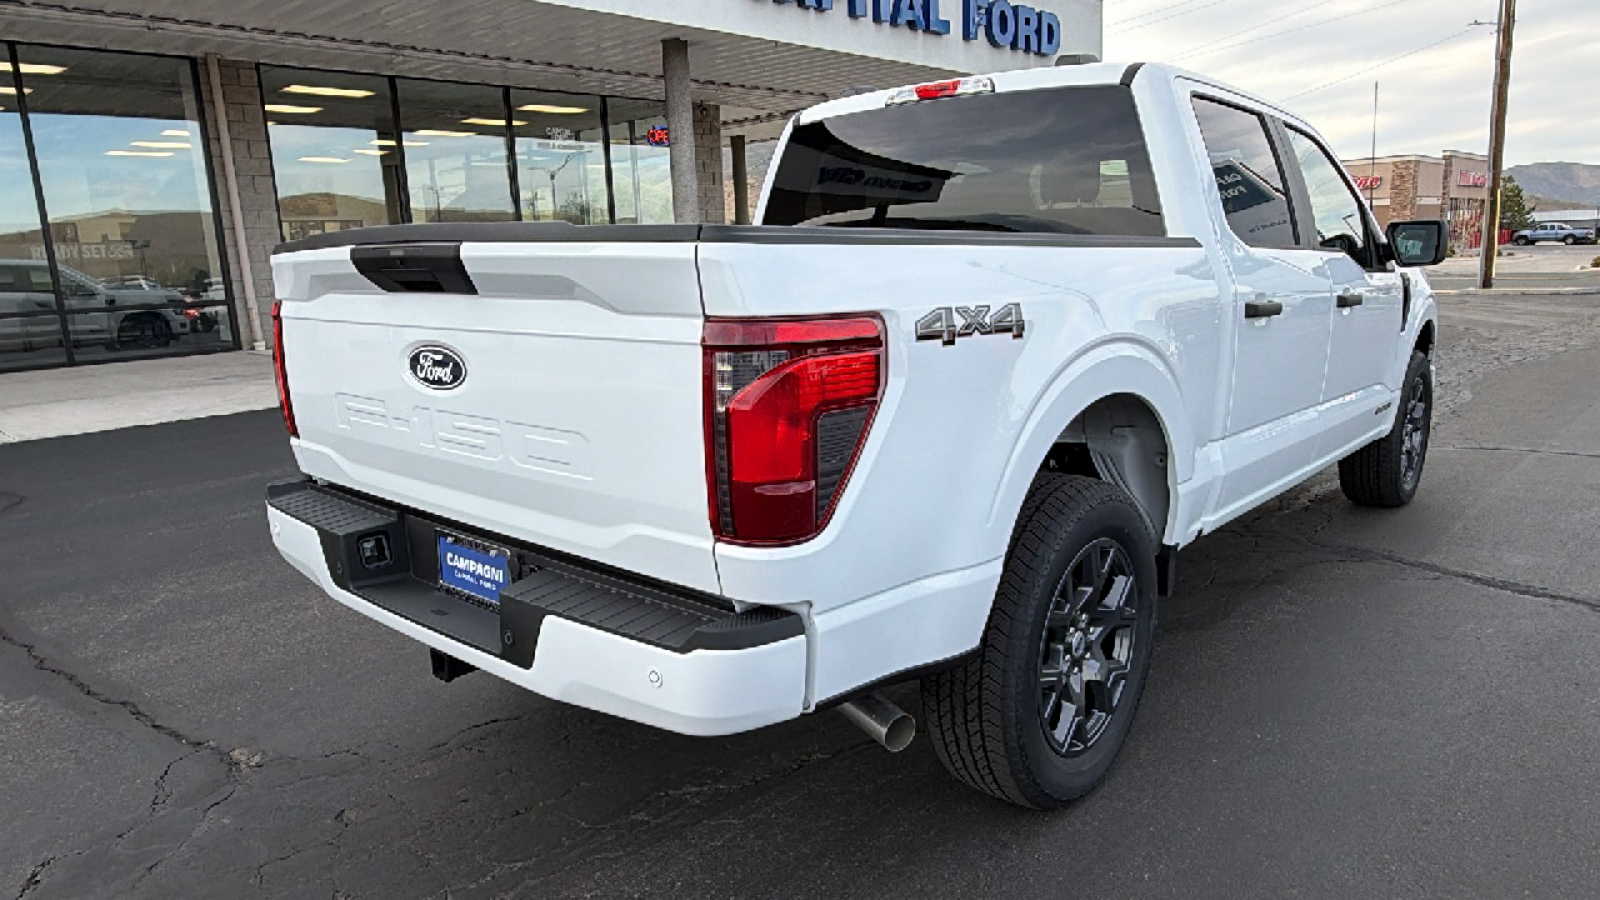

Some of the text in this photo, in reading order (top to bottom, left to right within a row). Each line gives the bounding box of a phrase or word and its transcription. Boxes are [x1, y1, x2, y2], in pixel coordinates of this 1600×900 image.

[962, 0, 1060, 55] FORD
[648, 129, 669, 142] OPE
[417, 352, 453, 383] Ford
[335, 391, 594, 480] F-150
[447, 552, 503, 584] CAMPAGNI
